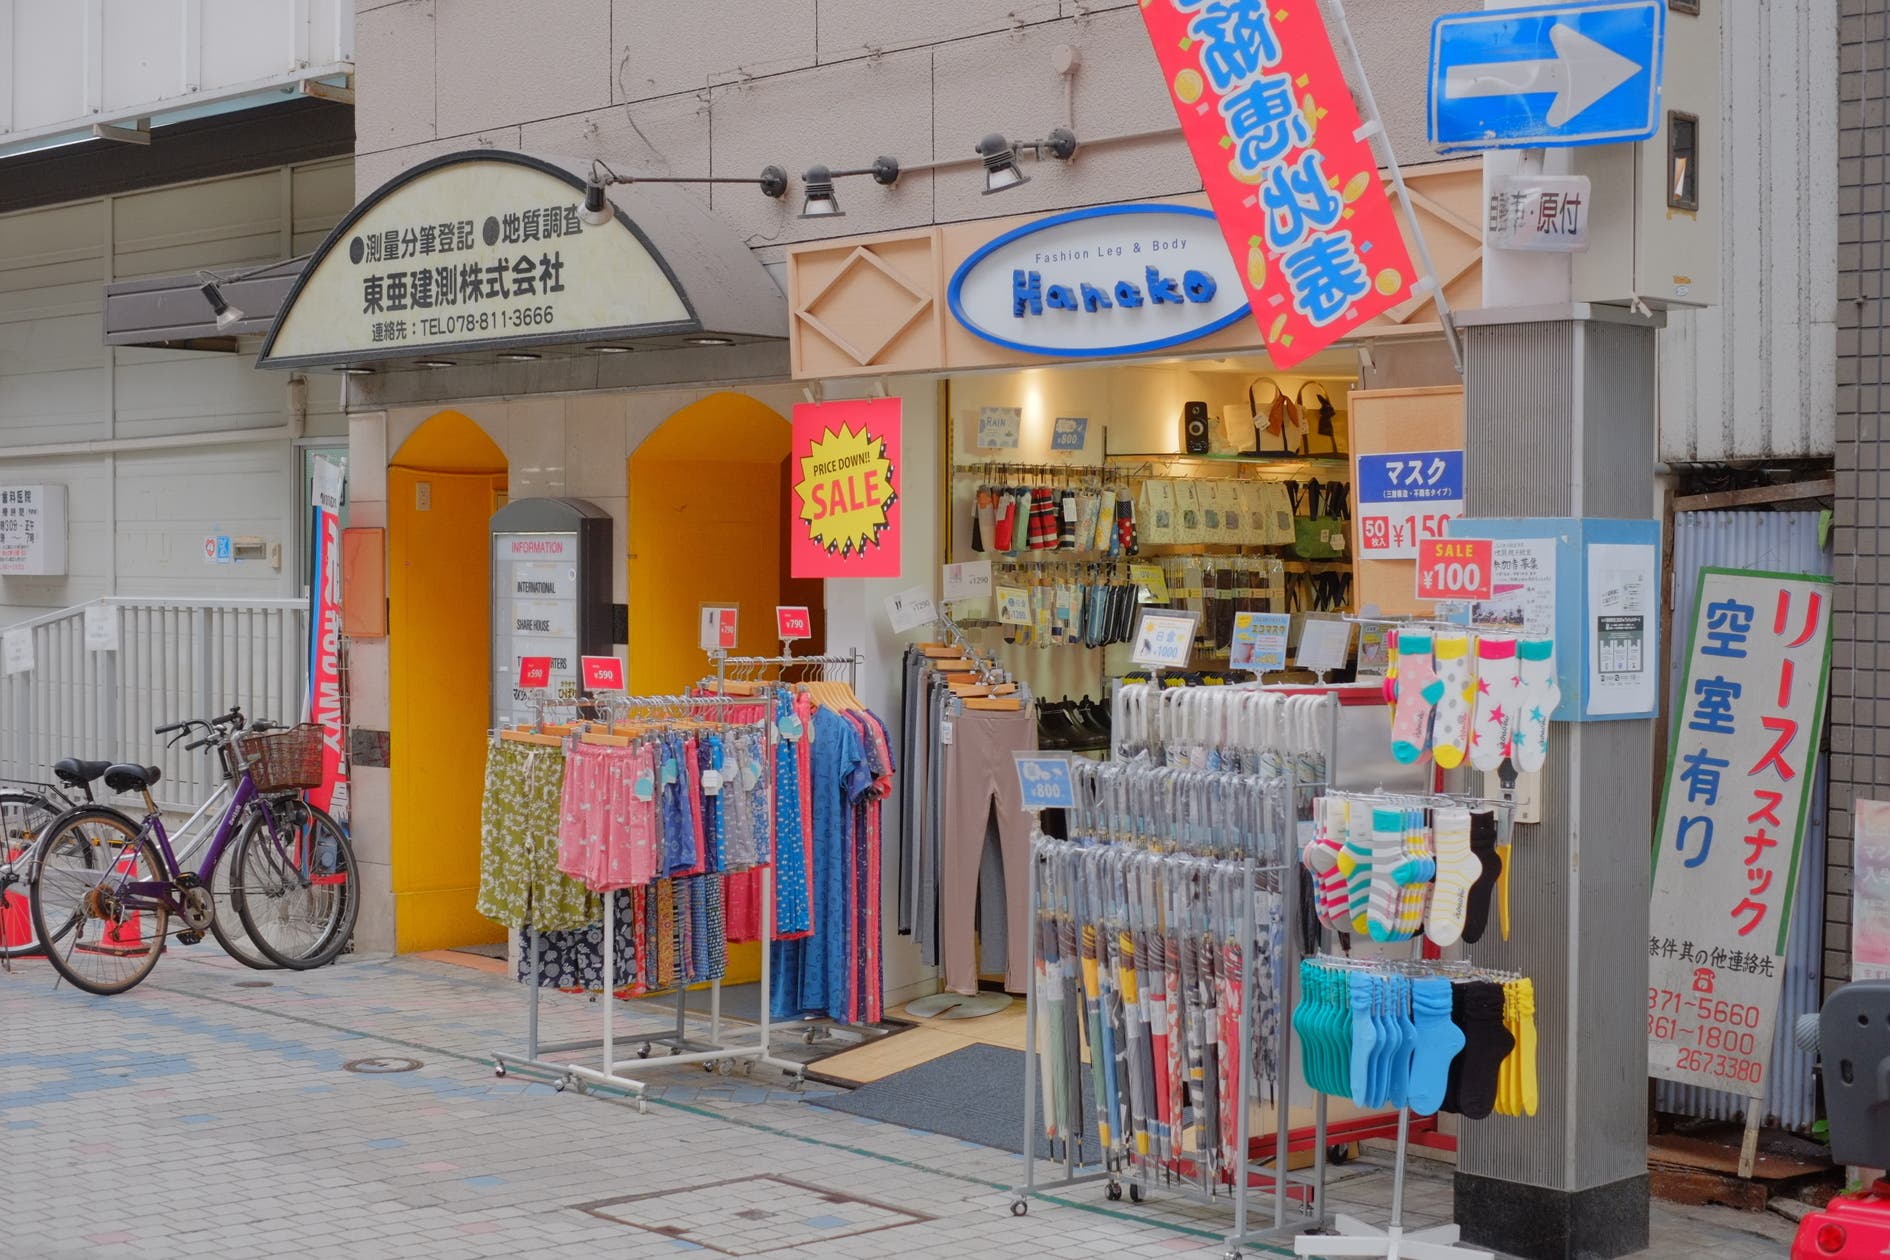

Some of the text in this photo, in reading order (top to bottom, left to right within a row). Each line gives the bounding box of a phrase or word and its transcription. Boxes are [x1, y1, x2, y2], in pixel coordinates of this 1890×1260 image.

[365, 203, 584, 263] 測量分筆登記 地質調査
[1035, 237, 1188, 264] Fashion Leg & Body
[363, 251, 566, 315] 東亜建測株式会社
[1012, 264, 1217, 318] Hanako
[813, 451, 871, 477] PRICE DOWN!!
[1386, 457, 1446, 486] マスク
[811, 469, 881, 521] SALE
[1365, 519, 1385, 537] 50
[512, 541, 563, 554] INFORMATION
[1435, 543, 1474, 558] SALE
[517, 580, 556, 594] INTERNATIONAL
[1423, 562, 1481, 592] ¥100
[516, 618, 550, 632] SHARE HOUSE
[1676, 599, 1754, 869] 空室有り
[1648, 936, 1775, 978] 条件其の他連絡先
